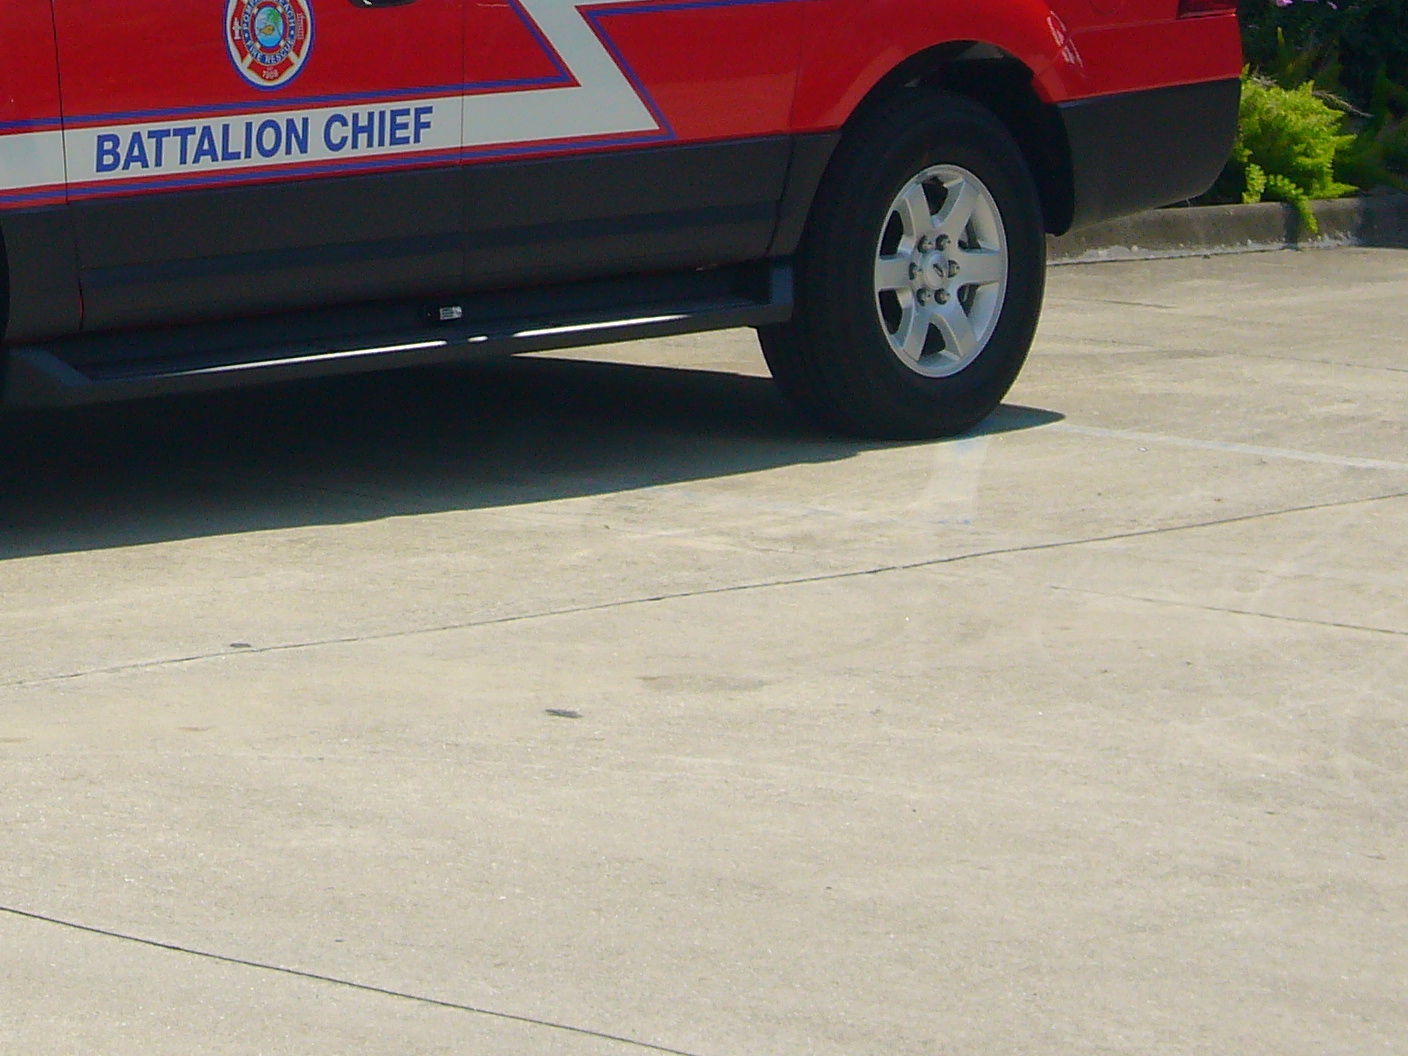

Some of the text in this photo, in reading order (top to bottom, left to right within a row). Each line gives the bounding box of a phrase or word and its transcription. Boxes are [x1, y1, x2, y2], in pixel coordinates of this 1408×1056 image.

[265, 39, 294, 64] RESCUE
[95, 107, 434, 172] BATTALION CHIEF
